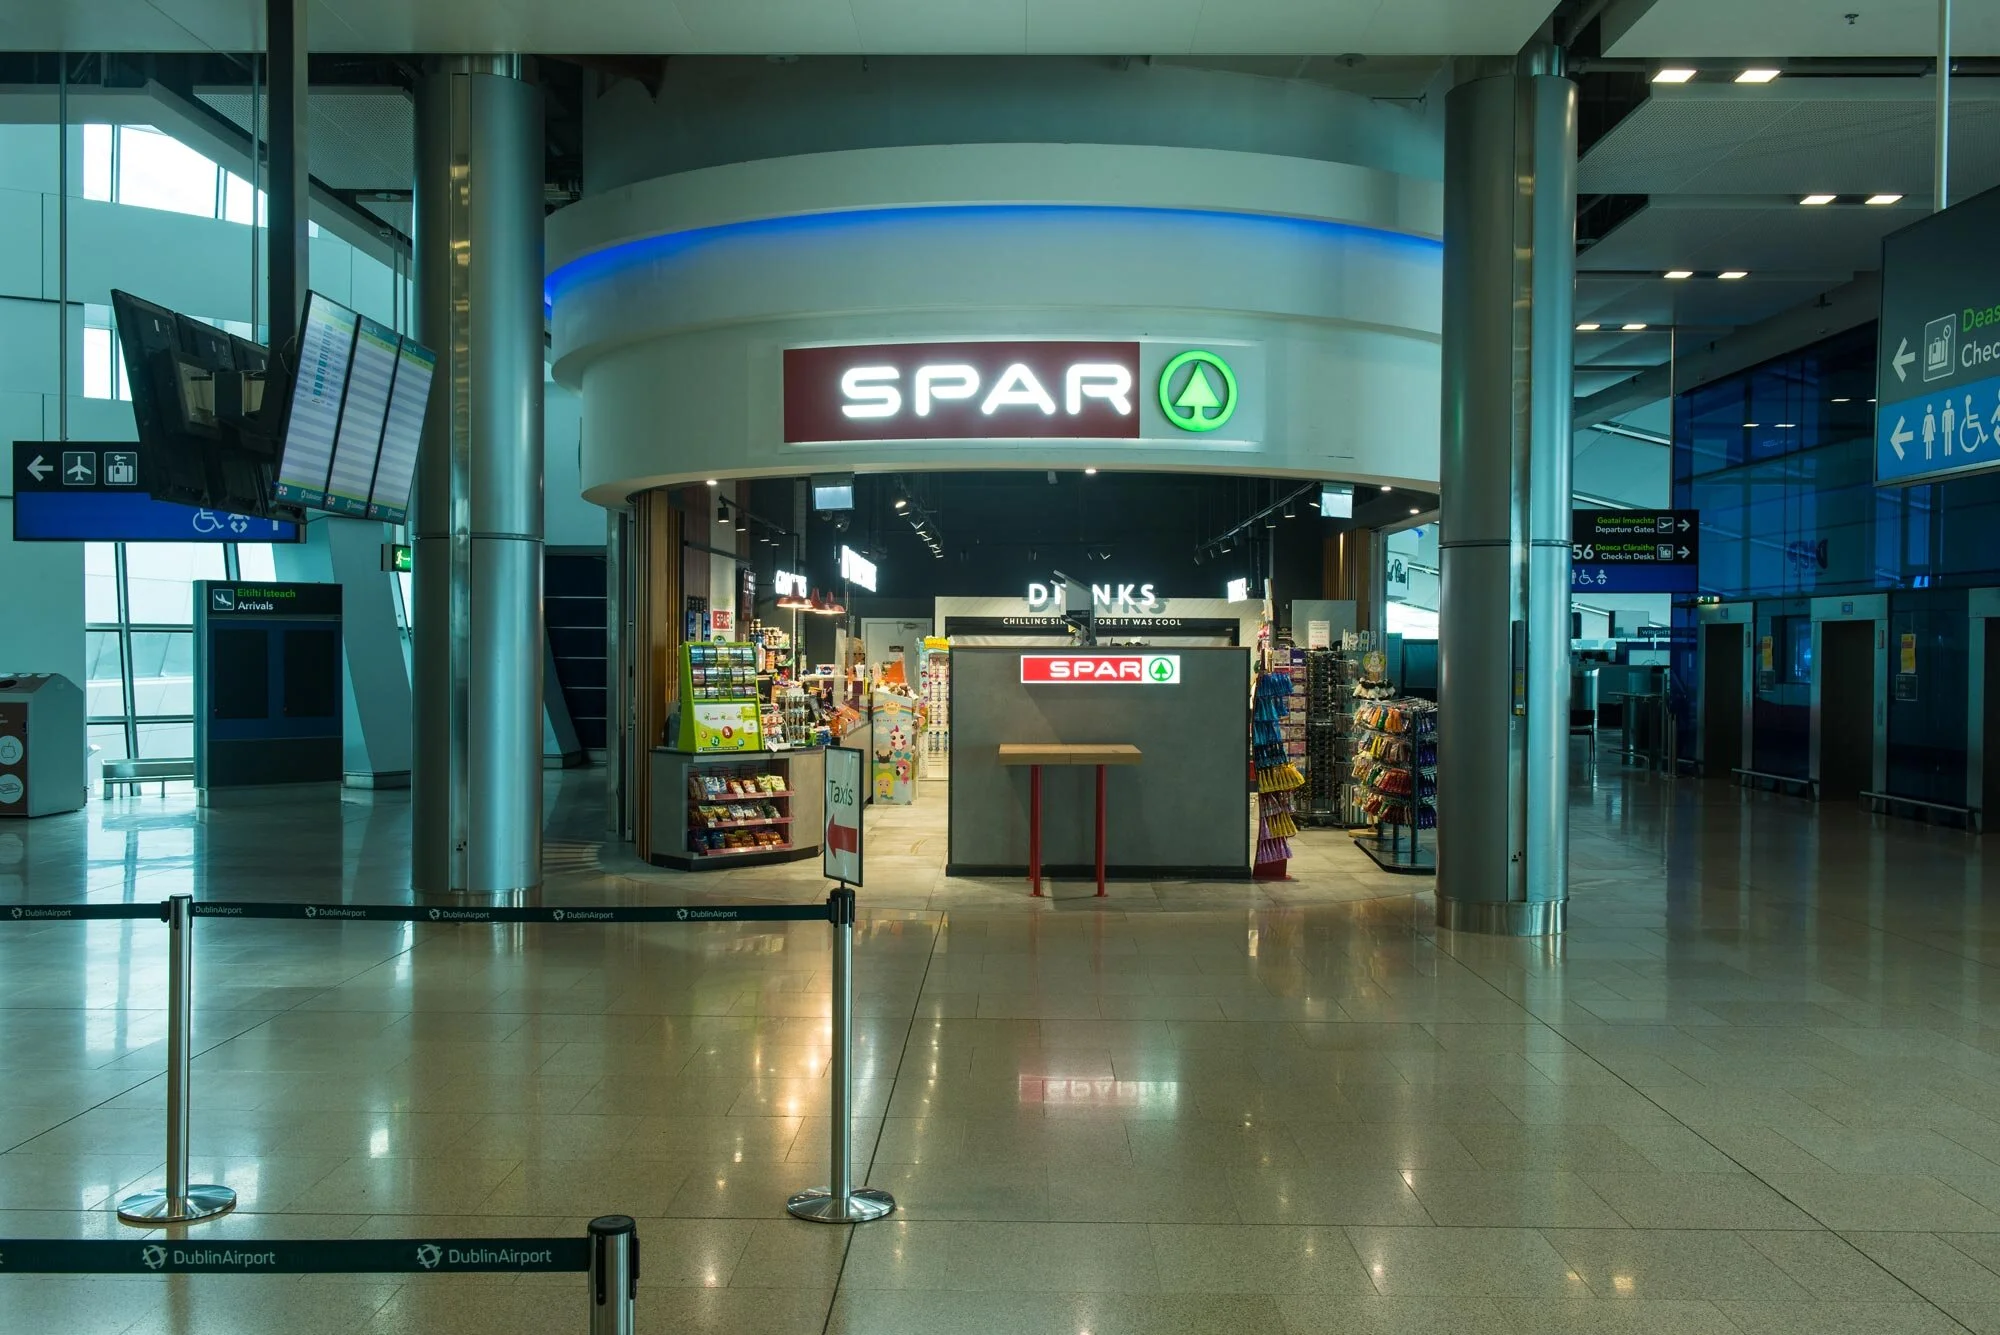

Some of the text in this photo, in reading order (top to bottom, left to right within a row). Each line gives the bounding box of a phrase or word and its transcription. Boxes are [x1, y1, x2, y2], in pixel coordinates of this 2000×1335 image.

[841, 362, 1133, 418] SPAR
[1622, 516, 1655, 524] Imeachta
[1595, 526, 1632, 534] Departure
[1601, 552, 1655, 560] Check-in Desks
[263, 588, 296, 598] Isteach
[1028, 583, 1156, 606] DNKS
[237, 601, 274, 610] Arrivals
[1003, 617, 1047, 626] CHILLING
[1121, 618, 1129, 627] IT
[1132, 618, 1153, 627] WAS
[1155, 618, 1182, 627] COOL
[1049, 661, 1141, 678] SPAR
[829, 779, 853, 807] Taxis
[25, 908, 72, 918] DublinAirport
[195, 906, 242, 915] DublinAirport
[319, 908, 367, 918] DublinAirport
[443, 910, 490, 920] DublinAirport
[567, 910, 614, 920] DublinAirport
[690, 909, 738, 919] DublinAirport
[174, 1249, 276, 1268] DublinAirport
[449, 1248, 553, 1267] DublinAirport
